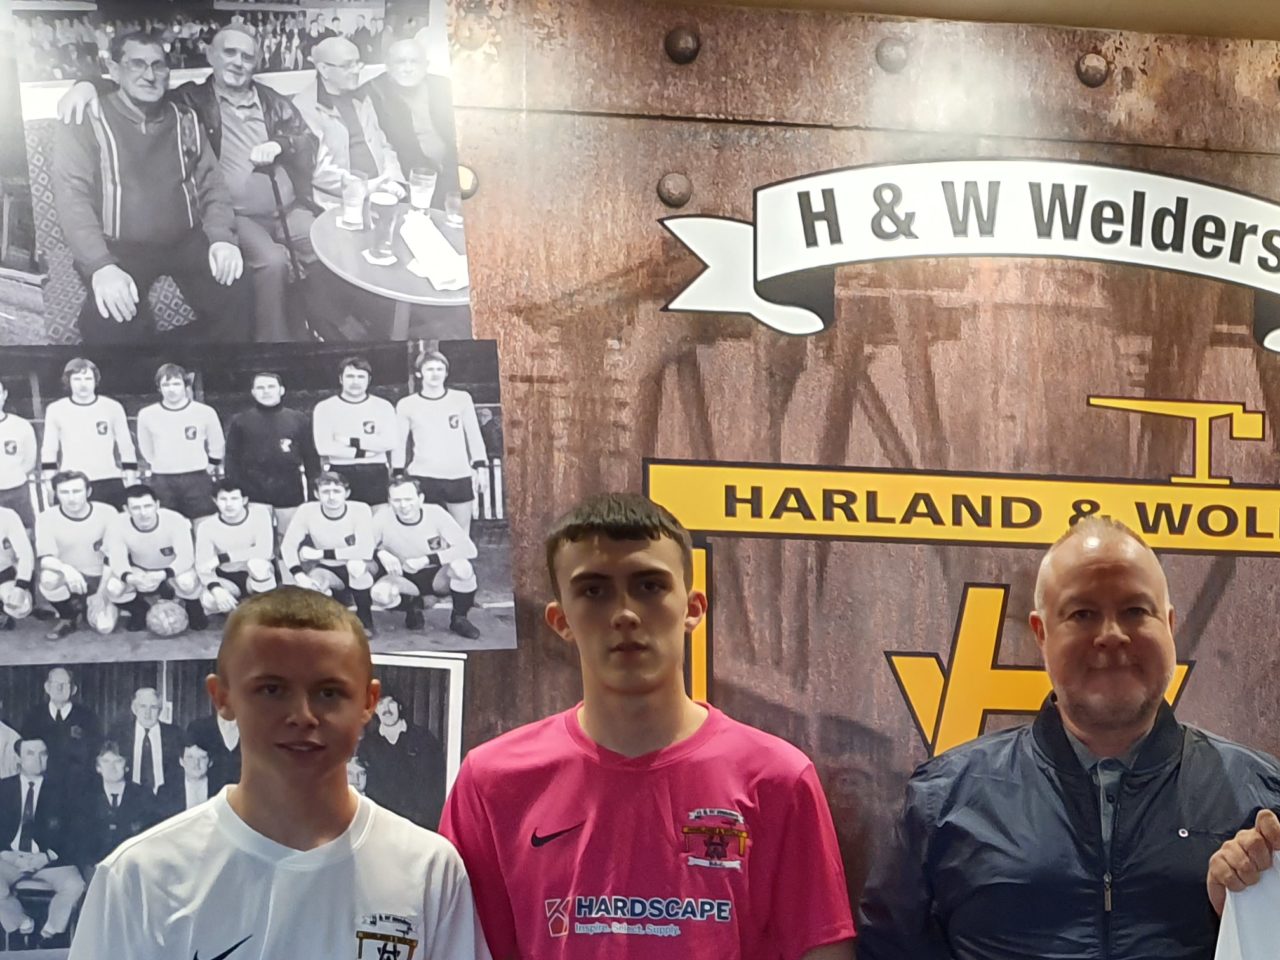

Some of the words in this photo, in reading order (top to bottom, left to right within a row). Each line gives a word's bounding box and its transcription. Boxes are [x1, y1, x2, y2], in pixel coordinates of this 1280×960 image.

[796, 187, 844, 249] H
[870, 182, 920, 241] &
[940, 180, 1001, 238] W
[723, 484, 1043, 530] HARLAND
[574, 896, 732, 922] HARDSCAPE
